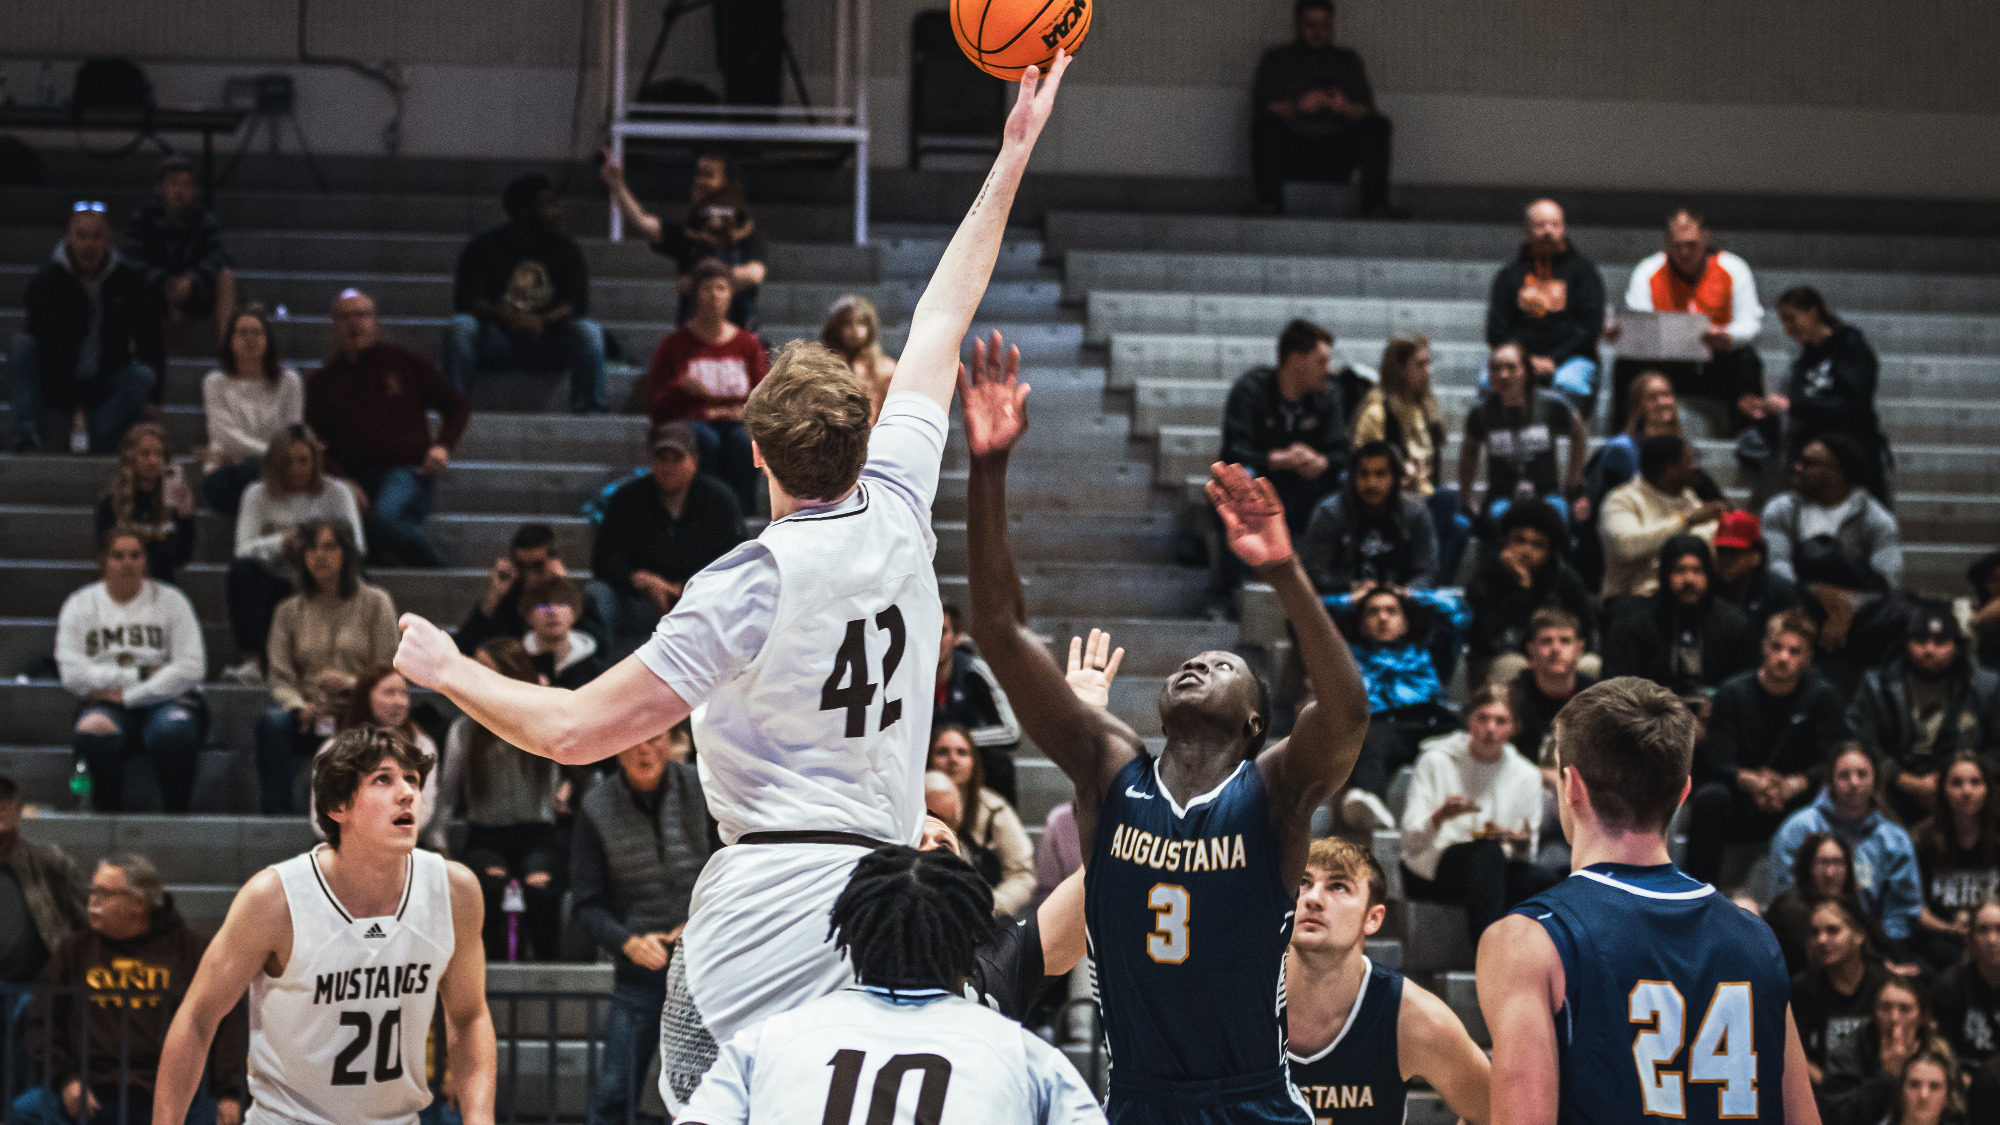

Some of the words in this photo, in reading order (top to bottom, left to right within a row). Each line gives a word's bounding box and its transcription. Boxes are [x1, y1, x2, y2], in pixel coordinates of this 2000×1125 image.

[1041, 0, 1087, 49] NCAA
[819, 604, 906, 738] 42
[1110, 823, 1246, 873] AUGUSTANA
[1146, 882, 1190, 965] 3
[313, 963, 431, 1004] MUSTANGS
[331, 1006, 403, 1086] 20
[1628, 979, 1759, 1119] 24
[822, 1049, 952, 1125] 10
